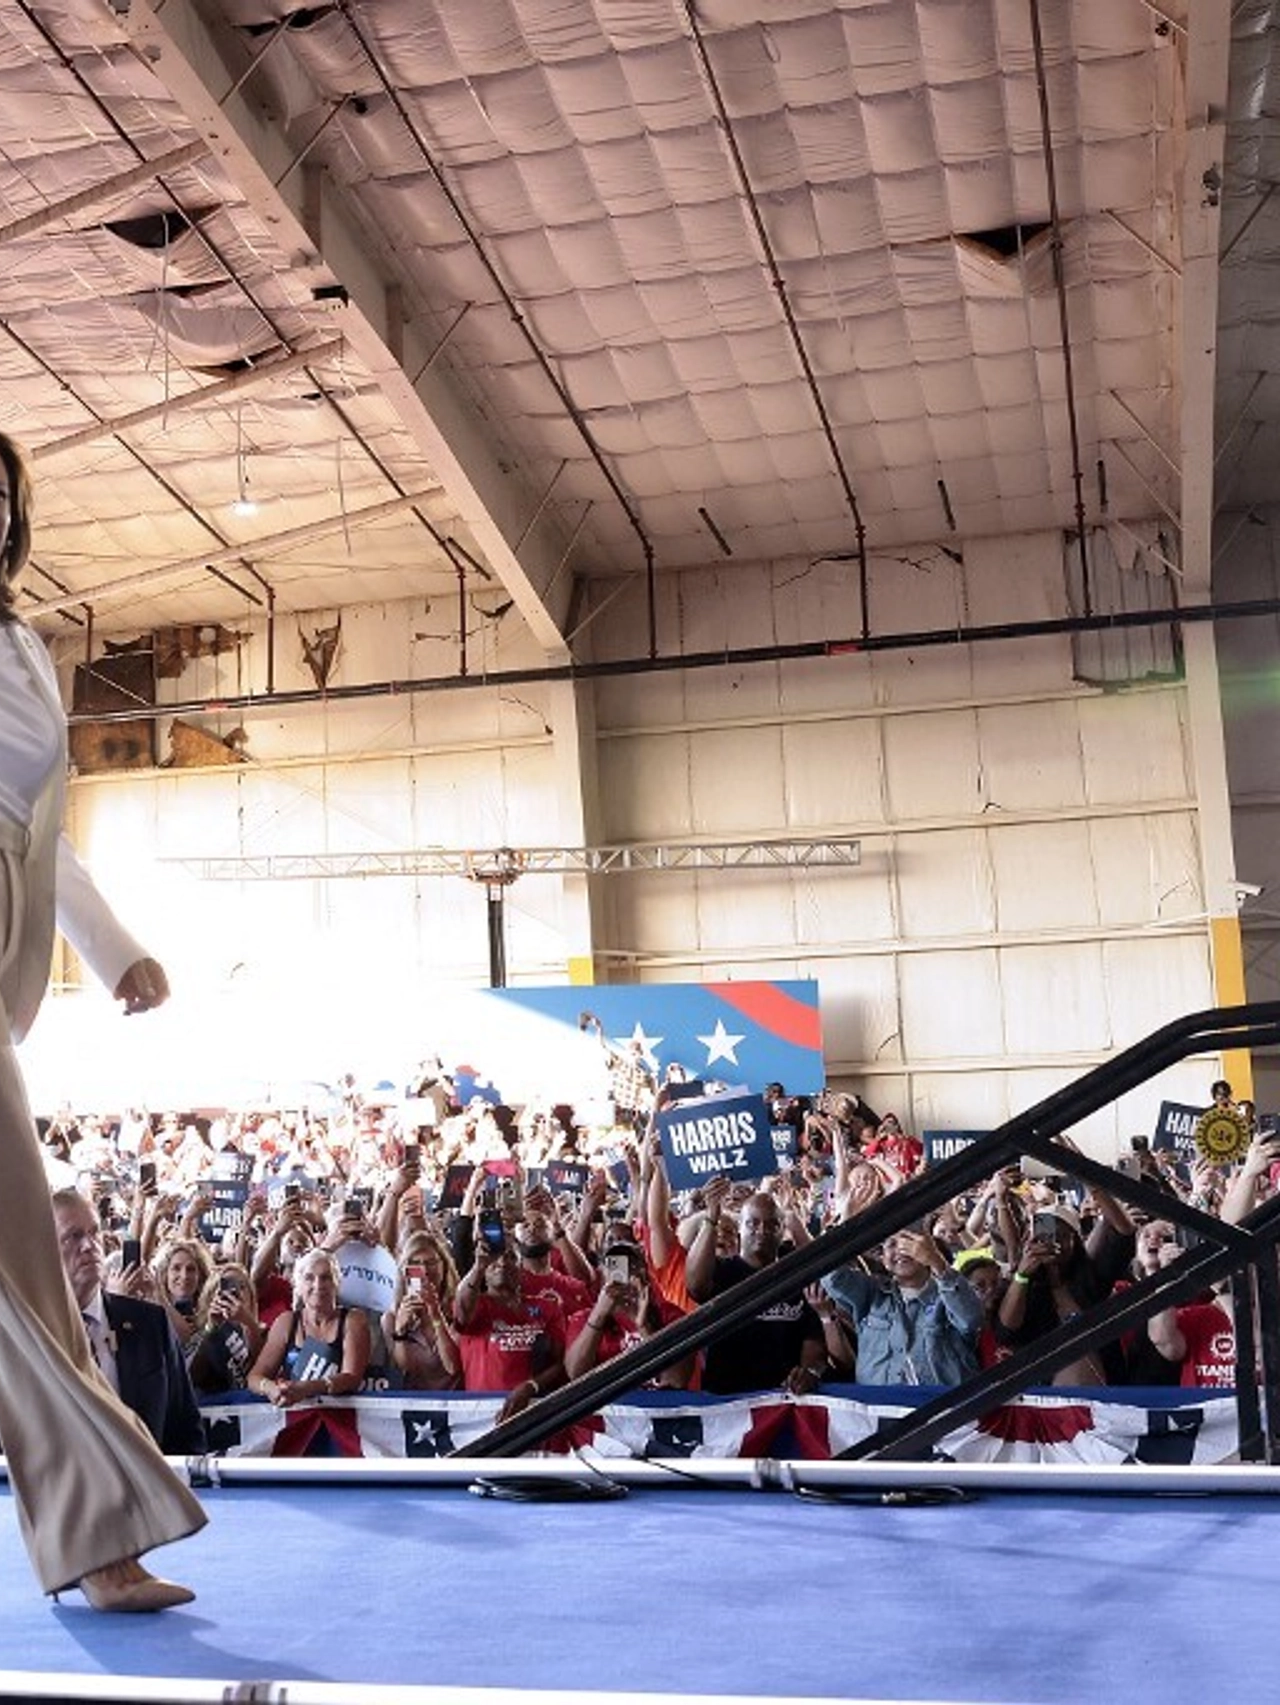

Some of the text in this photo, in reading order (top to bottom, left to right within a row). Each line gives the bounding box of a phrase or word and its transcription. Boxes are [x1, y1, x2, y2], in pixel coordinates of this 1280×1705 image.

[668, 1112, 757, 1156] HARRIS
[1165, 1111, 1199, 1136] HAR
[932, 1139, 976, 1160] HAR
[688, 1150, 749, 1174] WALZ
